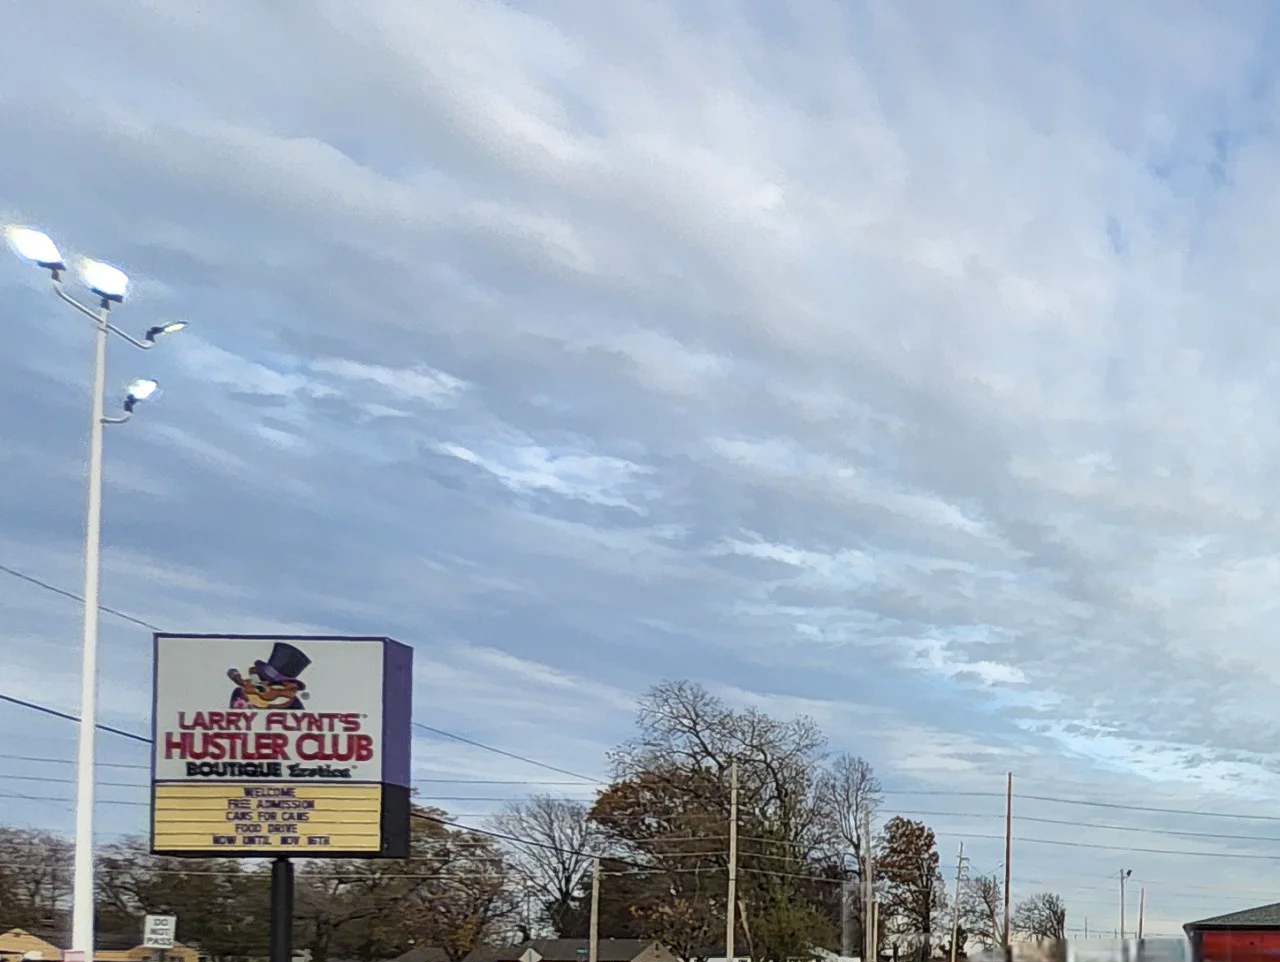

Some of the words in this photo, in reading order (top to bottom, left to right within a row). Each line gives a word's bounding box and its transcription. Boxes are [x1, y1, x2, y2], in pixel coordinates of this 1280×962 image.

[178, 711, 258, 731] LARRY
[165, 732, 290, 760] HUSTLER
[295, 733, 373, 761] CLUB
[186, 762, 282, 777] BOUTIQUE
[244, 788, 296, 797] WELCOME
[227, 799, 252, 809] FREE
[256, 800, 315, 809] ADMISSION
[257, 812, 277, 821] FOR
[235, 823, 262, 833] FOOD
[267, 824, 298, 833] DRIVE
[153, 919, 169, 927] DO
